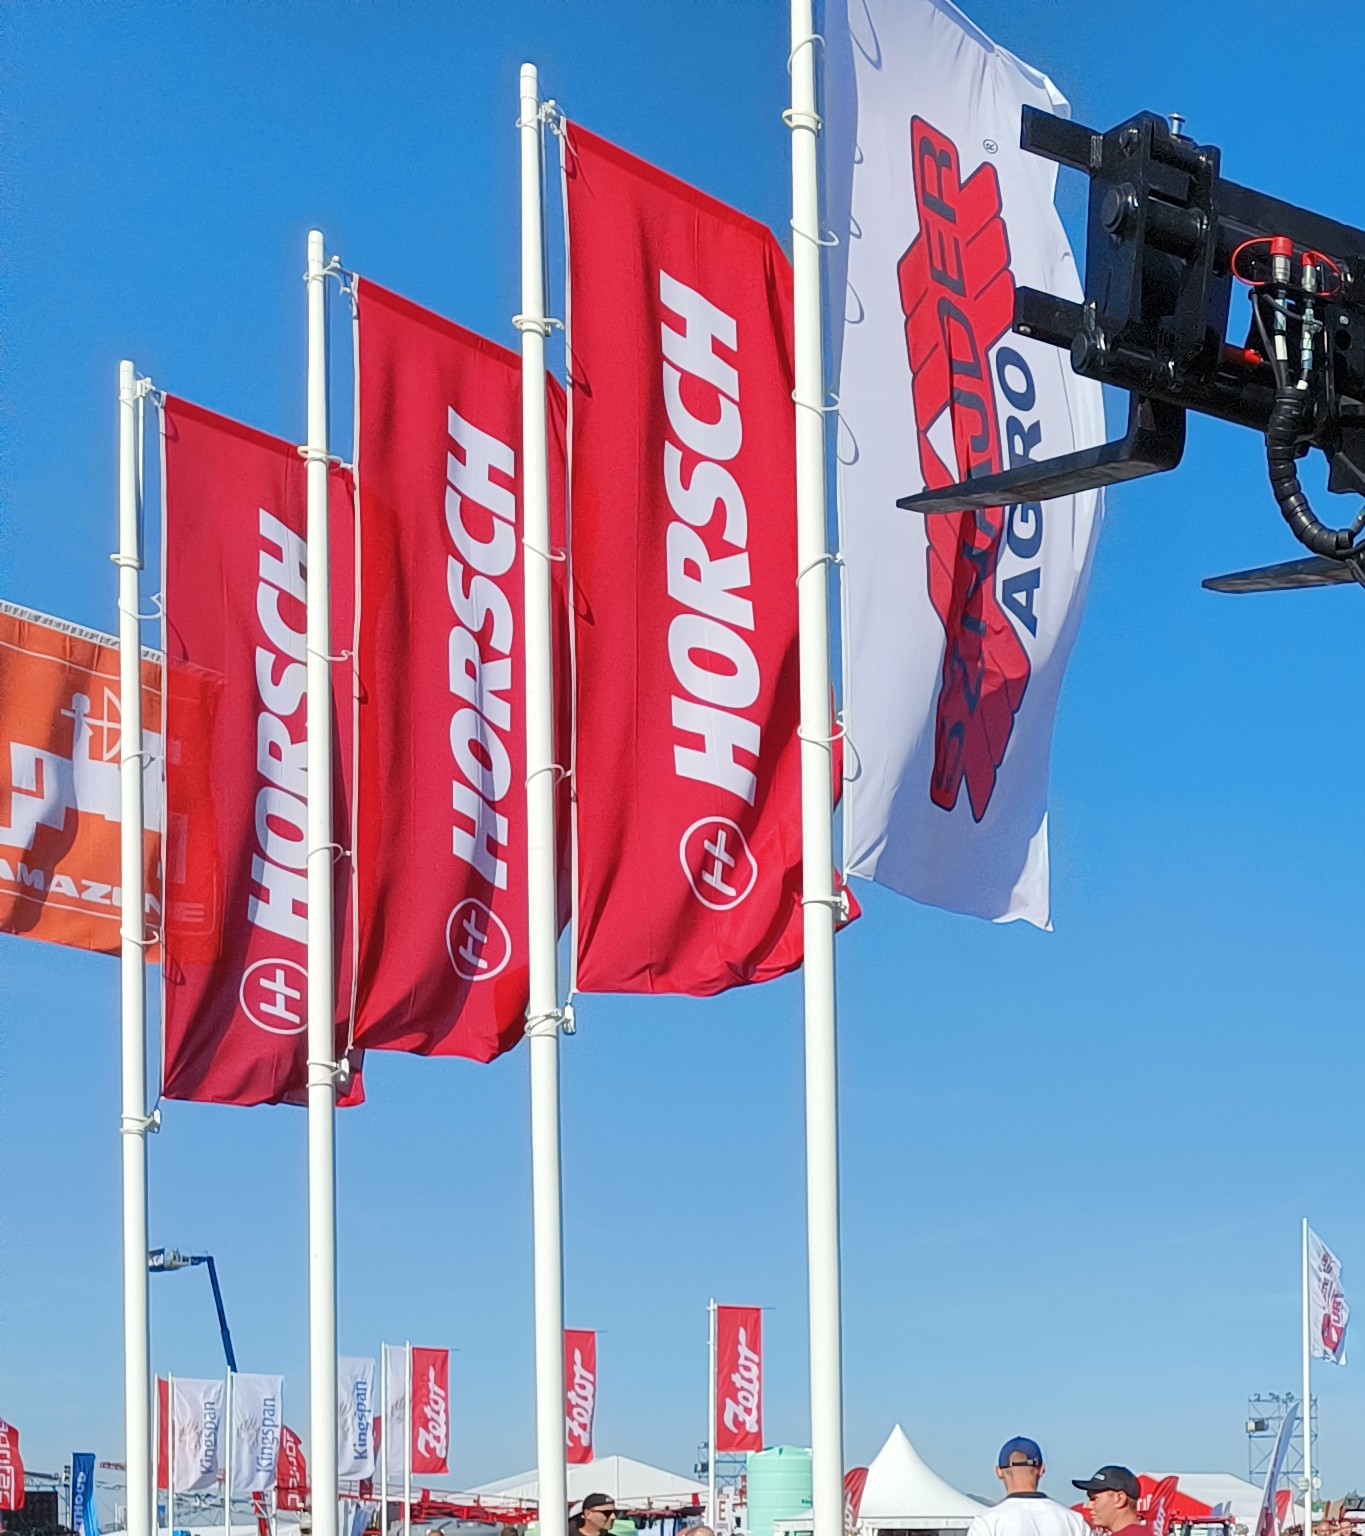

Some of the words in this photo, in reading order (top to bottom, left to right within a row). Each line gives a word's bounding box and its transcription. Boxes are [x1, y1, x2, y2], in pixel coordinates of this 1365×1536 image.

[660, 268, 761, 808] HORSCH
[996, 346, 1043, 638] AGRO
[444, 405, 517, 891] HORSCH
[247, 507, 309, 946] HORSCH
[353, 1380, 372, 1460] Kingspan
[417, 1365, 446, 1459] Zetor
[565, 1348, 594, 1447] Zetor
[723, 1326, 759, 1434] Zetor
[200, 1401, 219, 1475] Kingspan
[256, 1397, 279, 1474] Kingspan
